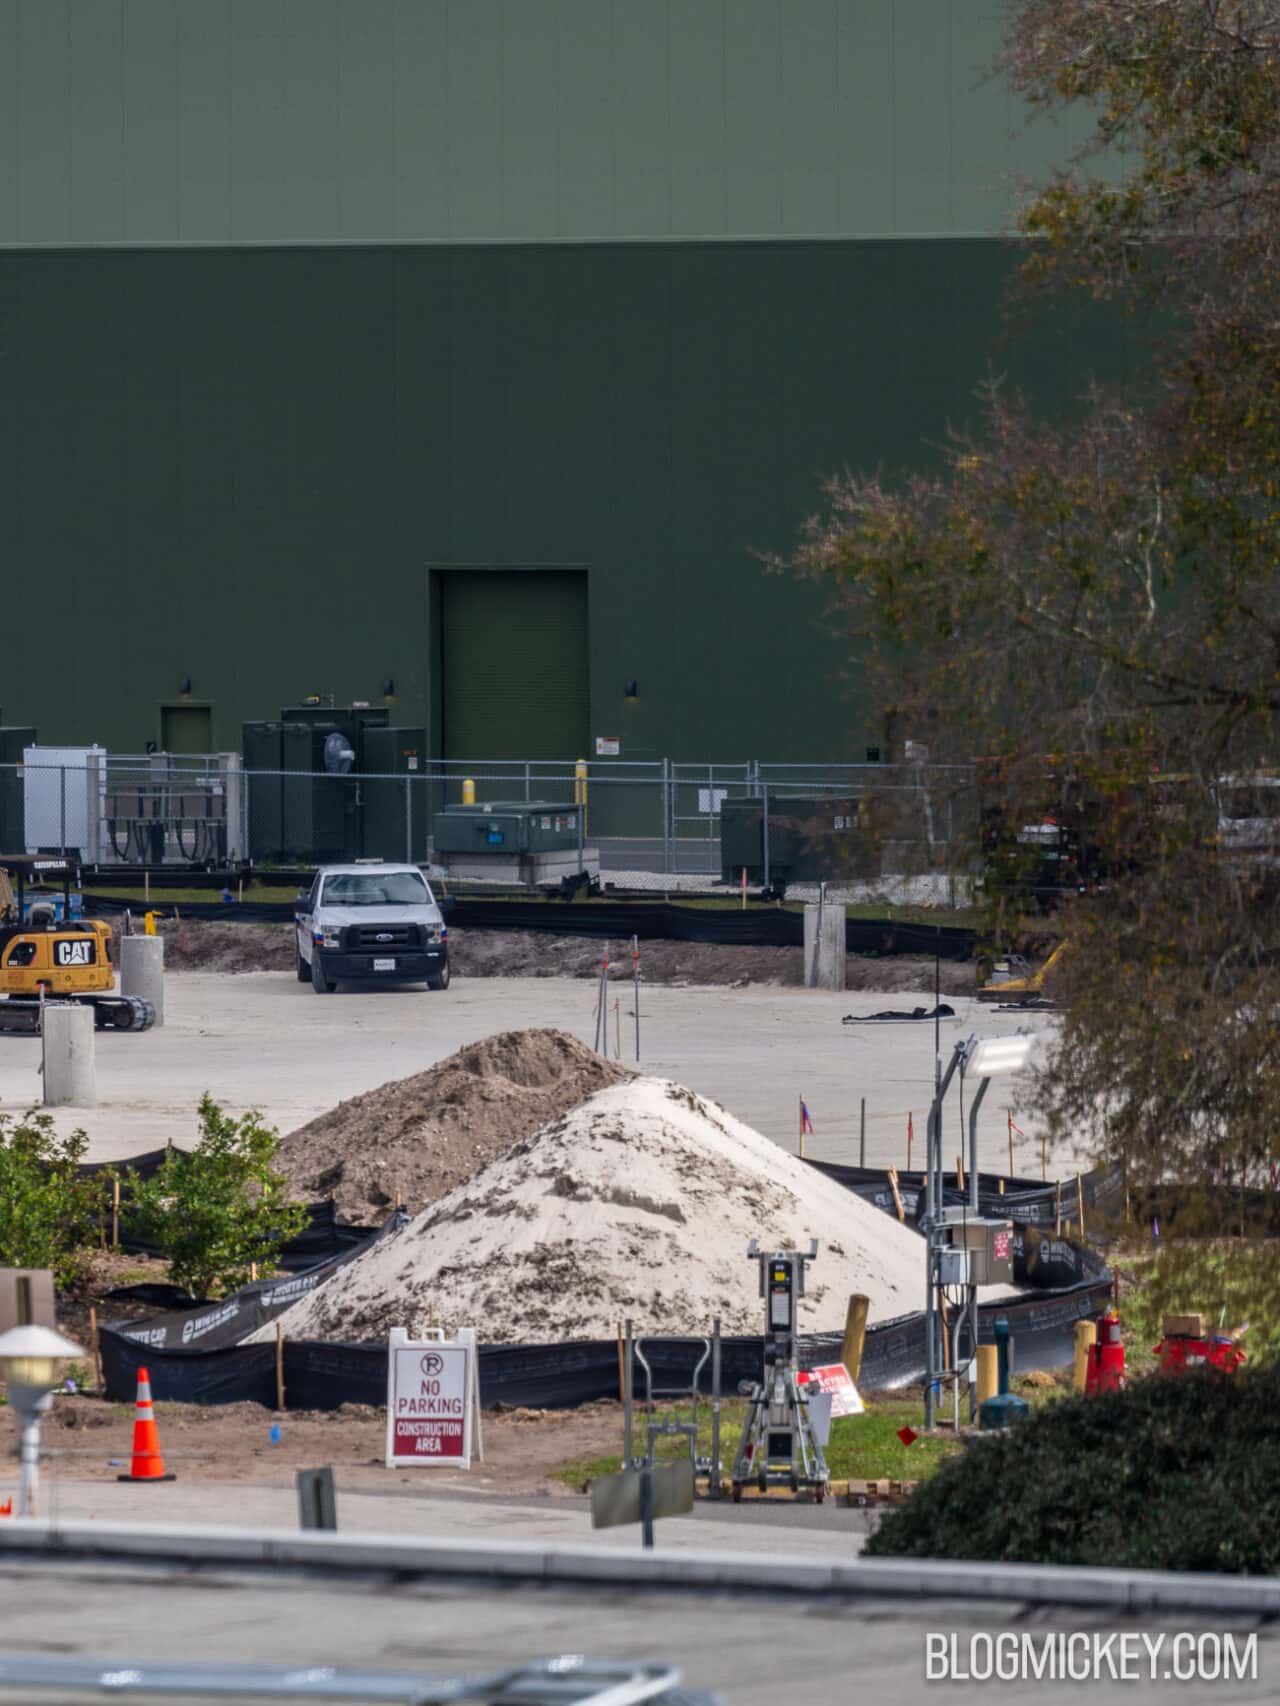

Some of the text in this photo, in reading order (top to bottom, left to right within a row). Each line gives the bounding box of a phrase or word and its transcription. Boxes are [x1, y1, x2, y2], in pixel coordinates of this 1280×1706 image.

[58, 941, 92, 965] CAT
[420, 1379, 440, 1396] NO
[399, 1398, 462, 1414] PARKING
[397, 1422, 461, 1437] CONSTRUCTION
[415, 1437, 442, 1452] AREA
